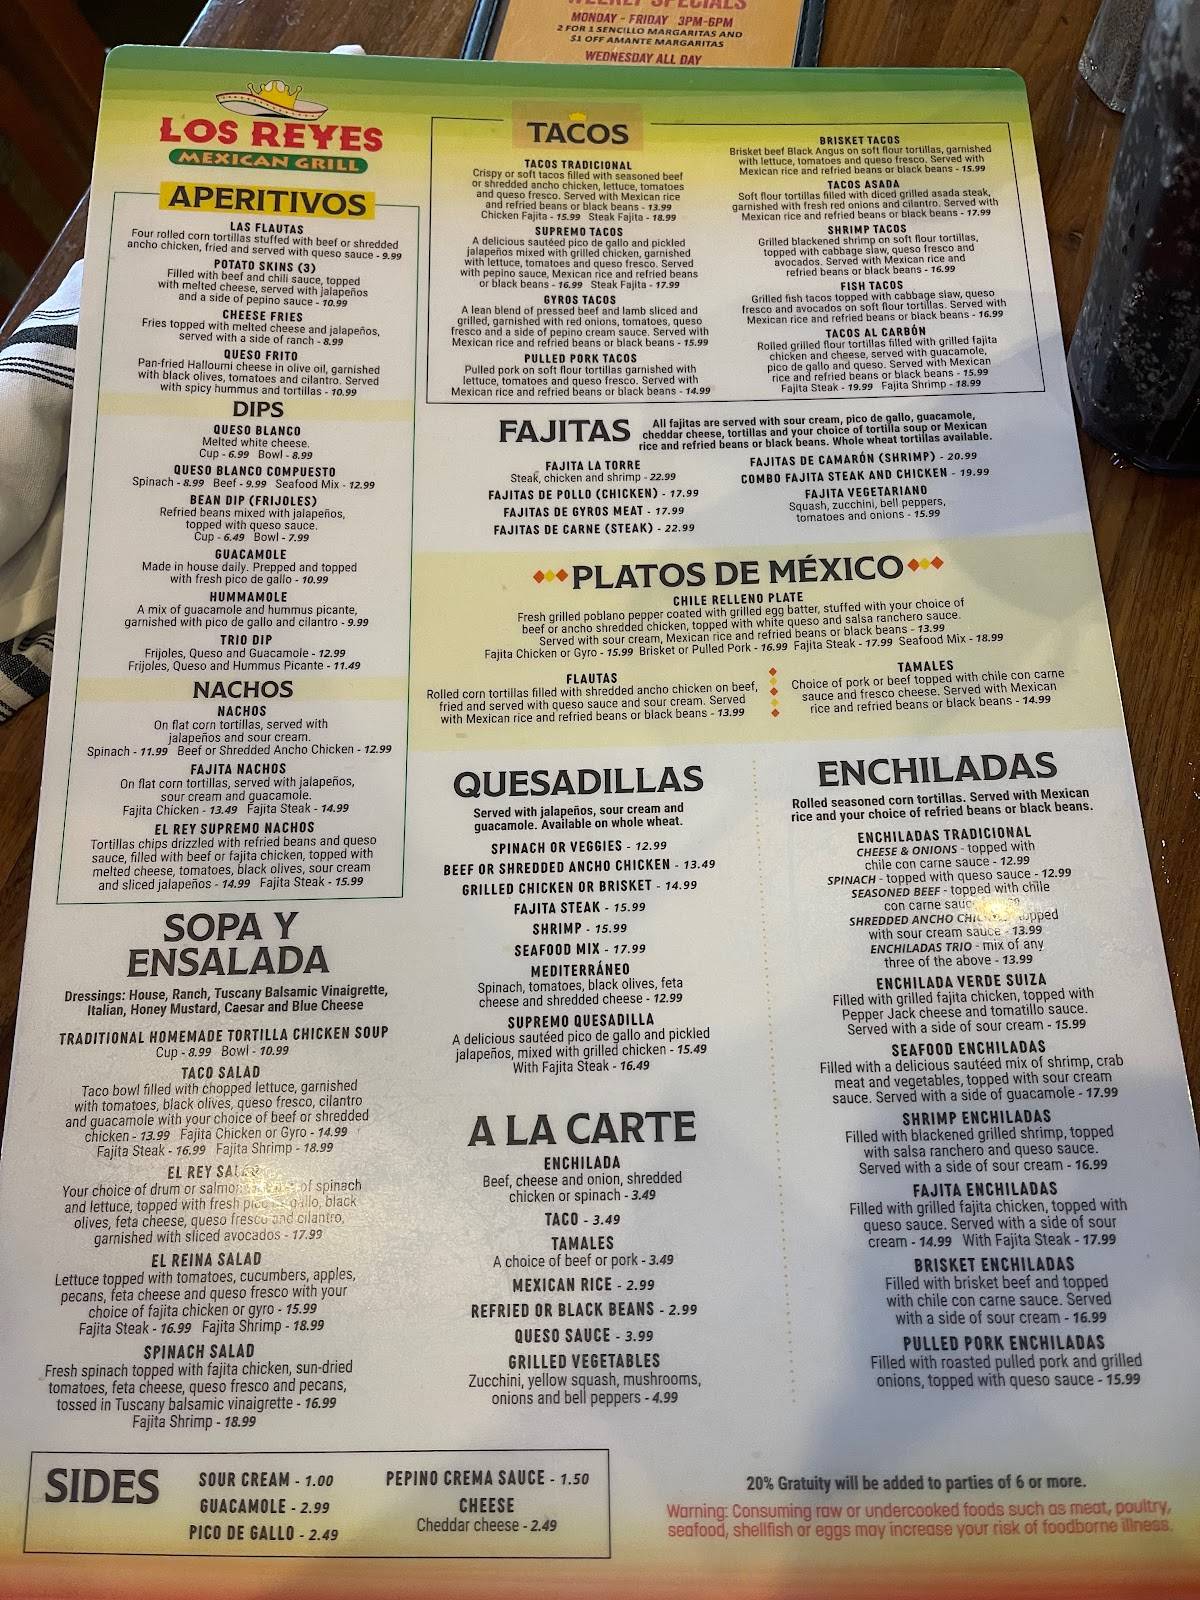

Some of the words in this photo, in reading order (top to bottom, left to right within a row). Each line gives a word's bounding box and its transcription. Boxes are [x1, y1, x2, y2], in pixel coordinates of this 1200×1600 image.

[570, 12, 617, 23] MONDAY
[628, 14, 669, 25] FRIDAY
[678, 16, 733, 27] 3PM-6PM
[596, 26, 645, 35] SENCILLO
[647, 28, 717, 38] MARGARITAS
[606, 37, 653, 45] AMANTE
[654, 38, 724, 48] MARGARITAS
[585, 50, 654, 63] WEDNESDAY
[655, 54, 676, 64] ALL
[680, 54, 702, 65] DAY
[160, 117, 238, 144] LOS
[252, 121, 383, 152] REYES
[527, 122, 629, 144] TACOS
[820, 136, 864, 145] BRISKET
[867, 135, 900, 144] TACOS
[178, 151, 288, 168] MEXICAN
[295, 157, 359, 172] GRILL
[524, 159, 557, 169] TACOS
[561, 160, 632, 170] TRADICIONAL
[828, 180, 861, 189] TACOS
[864, 179, 900, 189] ASADA
[168, 185, 367, 216] APERITIVOS
[230, 222, 250, 232] LAS
[255, 223, 304, 235] FLAUTAS
[535, 227, 586, 237] SUPREMO
[589, 227, 623, 237] TACOS
[828, 225, 869, 234] SHRIMP
[873, 224, 906, 233] TACOS
[214, 259, 254, 270] POTATO
[259, 261, 293, 272] SKINS
[298, 263, 316, 275] (3)
[841, 281, 865, 291] FISH
[869, 280, 903, 290] TACOS
[544, 295, 578, 304] GYROS
[582, 295, 616, 304] TACOS
[751, 294, 782, 304] Grilled
[785, 293, 803, 303] fish
[806, 294, 832, 303] tacos
[834, 292, 868, 304] topped
[871, 291, 891, 301] with
[894, 290, 935, 302] cabbage
[938, 290, 963, 301] slaw,
[966, 290, 996, 301] queso
[223, 310, 265, 321] CHEESE
[271, 312, 303, 322] FRIES
[825, 328, 860, 338] TACOS
[864, 328, 878, 338] AL
[882, 324, 926, 337] CARBÓN
[224, 349, 260, 361] QUESO
[266, 351, 298, 361] FRITO
[525, 354, 565, 363] PULLED
[569, 354, 599, 363] PORK
[603, 353, 637, 363] TACOS
[138, 358, 184, 369] Pan-fried
[188, 360, 233, 371] Halloumi
[236, 362, 272, 372] cheese
[276, 363, 284, 372] in
[287, 364, 310, 373] olive
[314, 364, 328, 375] oil,
[331, 365, 380, 376] garnished
[233, 401, 284, 417] DIPS
[214, 425, 250, 436] QUESO
[256, 426, 301, 436] BLANCO
[499, 419, 630, 443] FAJITAS
[545, 461, 584, 471] FAJITA
[588, 461, 602, 470] LA
[605, 460, 641, 470] TORRE
[215, 549, 287, 560] GUACAMOLE
[572, 562, 706, 590] PLATOS
[715, 560, 761, 585] DE
[769, 555, 904, 583] MÉXICO
[209, 591, 288, 603] HUMMAMOLE
[673, 595, 707, 606] CHILE
[712, 593, 764, 605] RELLENO
[768, 592, 804, 603] PLATE
[897, 660, 954, 673] TAMALES
[566, 673, 618, 685] FLAUTAS
[193, 680, 294, 699] NACHOS
[190, 763, 232, 775] FAJITA
[236, 763, 287, 775] NACHOS
[818, 751, 1057, 787] ENCHILADAS
[453, 766, 704, 798] QUESADILLAS
[155, 824, 169, 836] EL
[173, 824, 196, 835] REY
[200, 823, 259, 834] SUPREMO
[264, 821, 315, 834] NACHOS
[857, 829, 940, 844] ENCHILADAS
[943, 826, 1032, 841] TRADICIONAL
[163, 912, 263, 942] SOPA
[273, 911, 299, 940] Y
[127, 945, 330, 978] ENSALADA
[531, 961, 630, 978] MEDITERRÁNEO
[876, 976, 953, 990] ENCHILADA
[957, 974, 1002, 988] VERDE
[1006, 972, 1047, 986] SUIZA
[181, 1066, 213, 1079] TACO
[218, 1065, 261, 1079] SALAD
[468, 1115, 496, 1147] A
[506, 1114, 556, 1146] LA
[567, 1111, 697, 1144] CARTE
[544, 1155, 621, 1170] ENCHILADA
[151, 1254, 166, 1268] EL
[172, 1253, 213, 1267] REINA
[217, 1251, 262, 1266] SALAD
[903, 1336, 961, 1351] PULLED
[964, 1335, 1005, 1350] PORK
[1009, 1334, 1106, 1351] ENCHILADAS
[143, 1344, 204, 1359] SPINACH
[209, 1343, 255, 1358] SALAD
[45, 1468, 160, 1505] SIDES
[747, 1475, 774, 1491] 20%
[778, 1475, 831, 1494] Gratuity
[835, 1475, 859, 1490] will
[863, 1475, 879, 1490] be
[883, 1475, 923, 1490] added
[928, 1477, 942, 1490] to
[946, 1475, 993, 1493] parties
[998, 1474, 1012, 1489] of
[1016, 1475, 1025, 1489] 6
[1029, 1477, 1042, 1489] or
[1047, 1476, 1087, 1489] more.
[667, 1503, 728, 1521] Warning:
[733, 1503, 812, 1521] Consuming
[816, 1506, 843, 1518] raw
[847, 1506, 860, 1518] or
[865, 1502, 959, 1518] undercooked
[964, 1501, 1004, 1517] foods
[1009, 1501, 1045, 1516] such
[1049, 1503, 1066, 1515] as
[1070, 1501, 1112, 1516] meat,
[1116, 1499, 1172, 1516] poultry,
[668, 1522, 729, 1539] seafood,
[733, 1521, 793, 1537] shellfish
[797, 1524, 811, 1536] or
[816, 1524, 850, 1540] eggs
[855, 1524, 884, 1539] may
[889, 1521, 952, 1536] increase
[956, 1522, 990, 1538] your
[993, 1519, 1020, 1535] risk
[1025, 1519, 1038, 1534] of
[1042, 1519, 1118, 1535] foodborne
[1122, 1518, 1173, 1533] illness.
